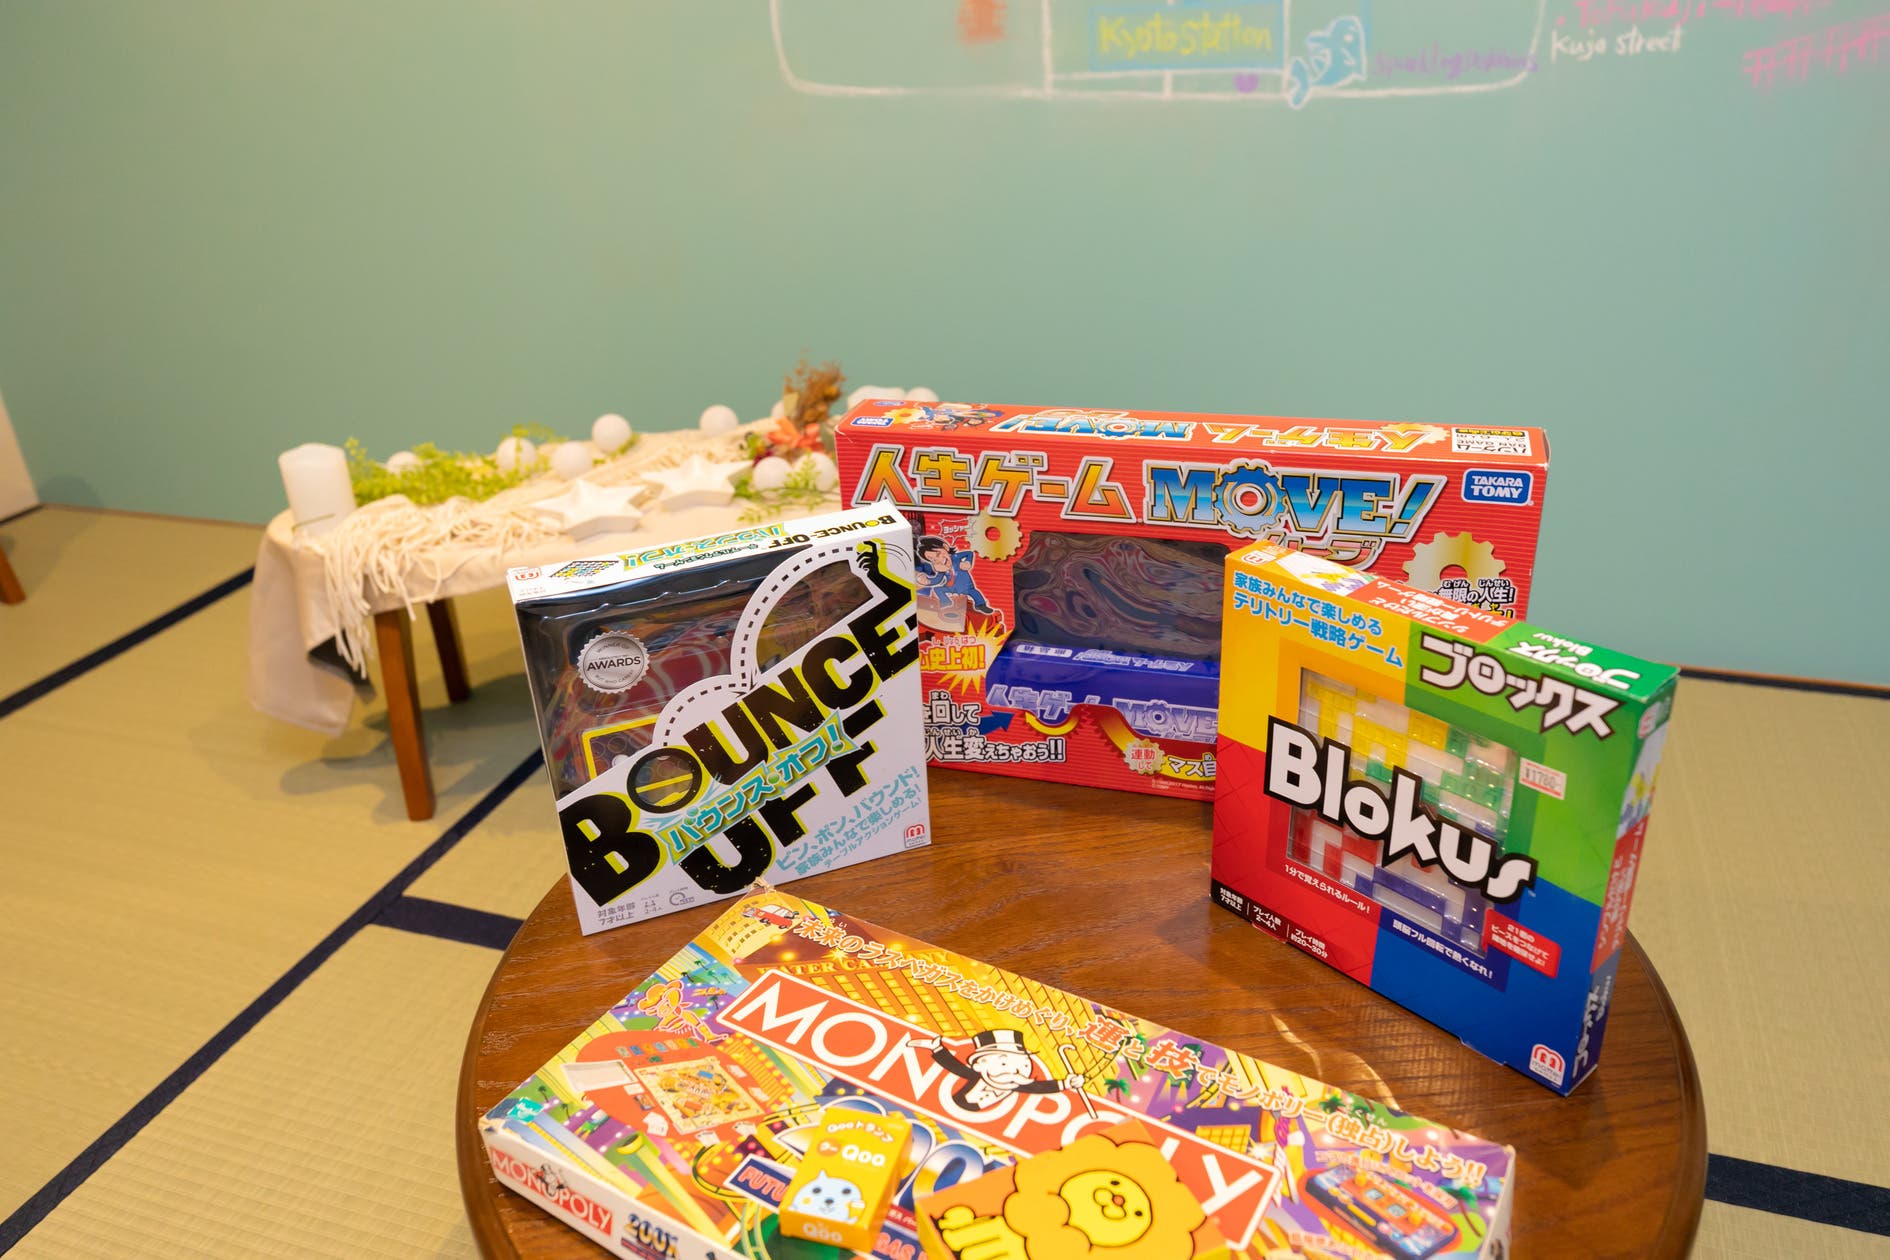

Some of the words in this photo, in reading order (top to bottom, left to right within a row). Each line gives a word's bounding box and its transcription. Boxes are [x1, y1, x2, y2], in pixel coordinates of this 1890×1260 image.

[1205, 421, 1434, 452] 人生ゲーム
[855, 446, 1132, 519] 人生ゲーム
[1147, 462, 1445, 535] MOVE!
[1471, 485, 1522, 498] TOMY
[1472, 476, 1523, 487] TAKARA
[1233, 571, 1383, 636] 家族みんなで楽しめる
[1233, 594, 1404, 668] テリトリー戦略ゲーム
[587, 656, 641, 671] AWARDS
[1420, 633, 1619, 736] ブロックス
[1267, 719, 1535, 900] Blokus
[841, 1144, 886, 1167] Qoo
